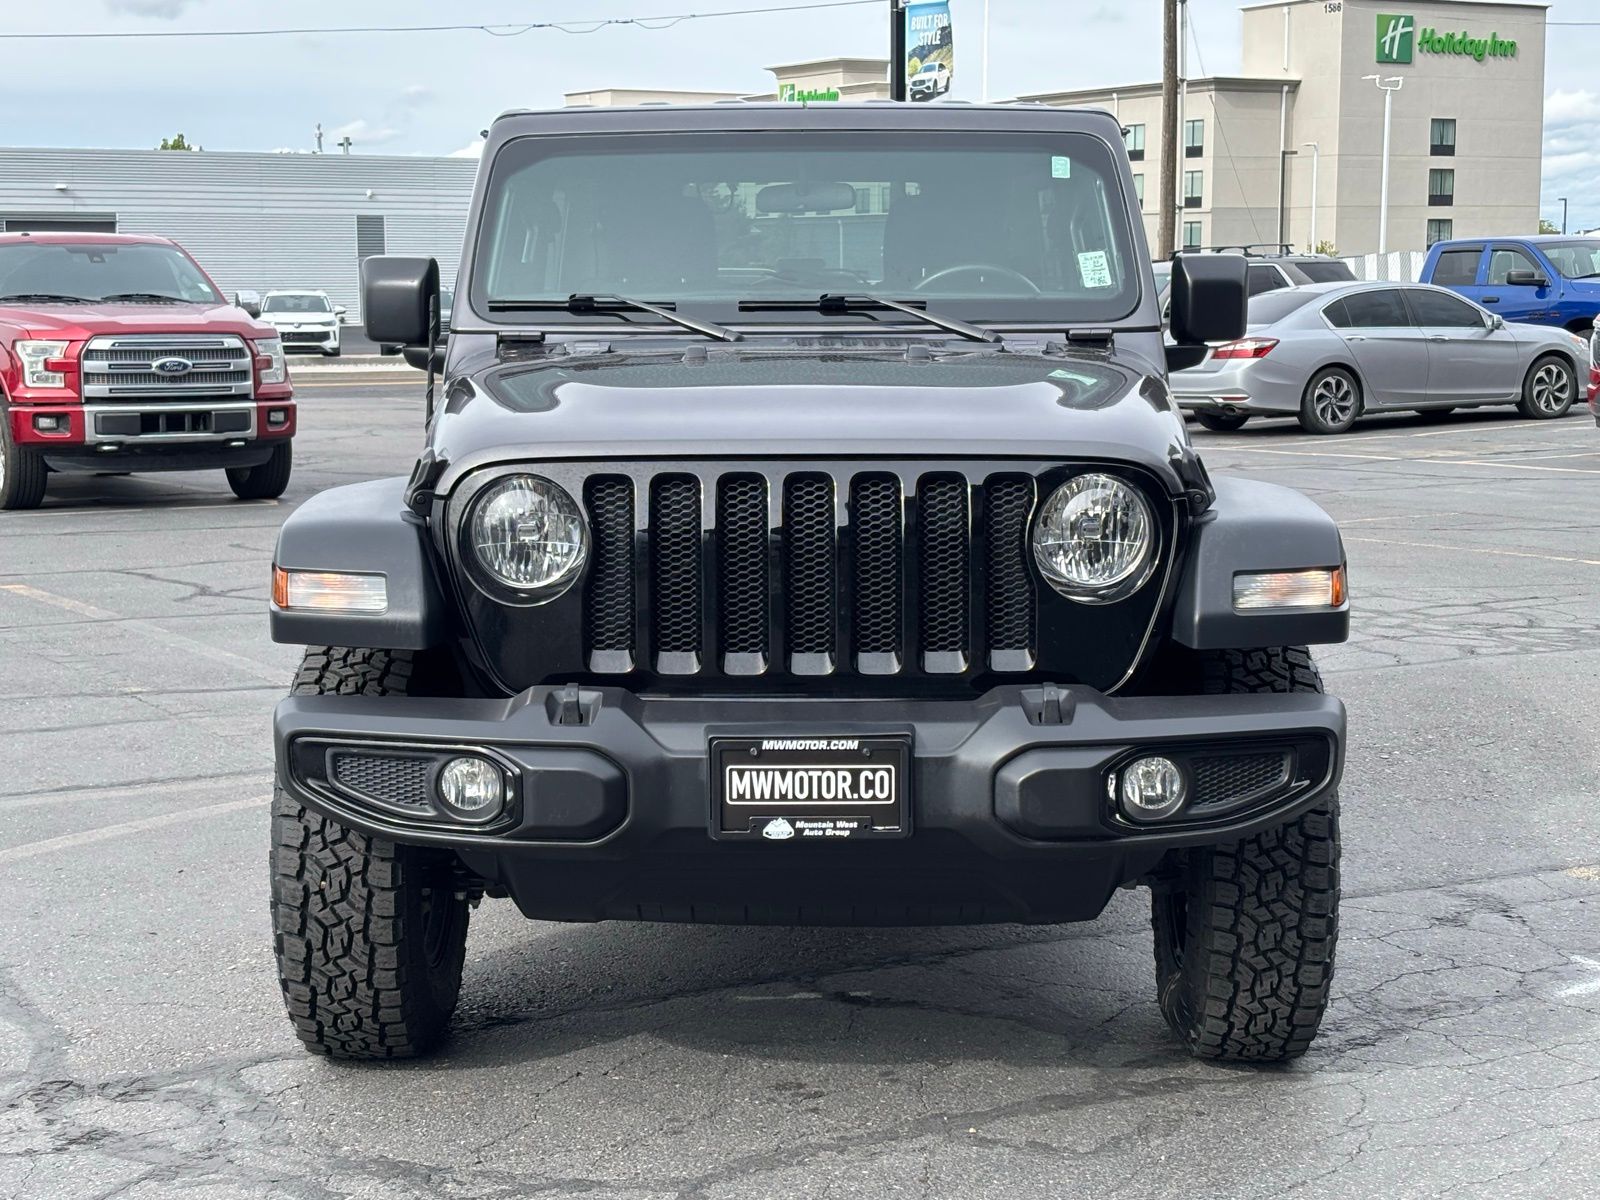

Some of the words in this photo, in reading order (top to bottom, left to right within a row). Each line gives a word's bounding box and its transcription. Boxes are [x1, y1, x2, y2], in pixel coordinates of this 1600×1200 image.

[911, 15, 932, 30] BUILT
[933, 13, 949, 27] FOR
[919, 31, 941, 45] STYLE
[1418, 28, 1487, 61] Holiday
[1488, 32, 1517, 57] Inn
[762, 740, 859, 751] MWMOTOR.COM
[731, 770, 890, 800] MWMOTOR.CO
[795, 820, 834, 829] Mountain
[836, 820, 858, 829] West
[803, 828, 823, 837] Auto
[825, 828, 850, 838] Group
